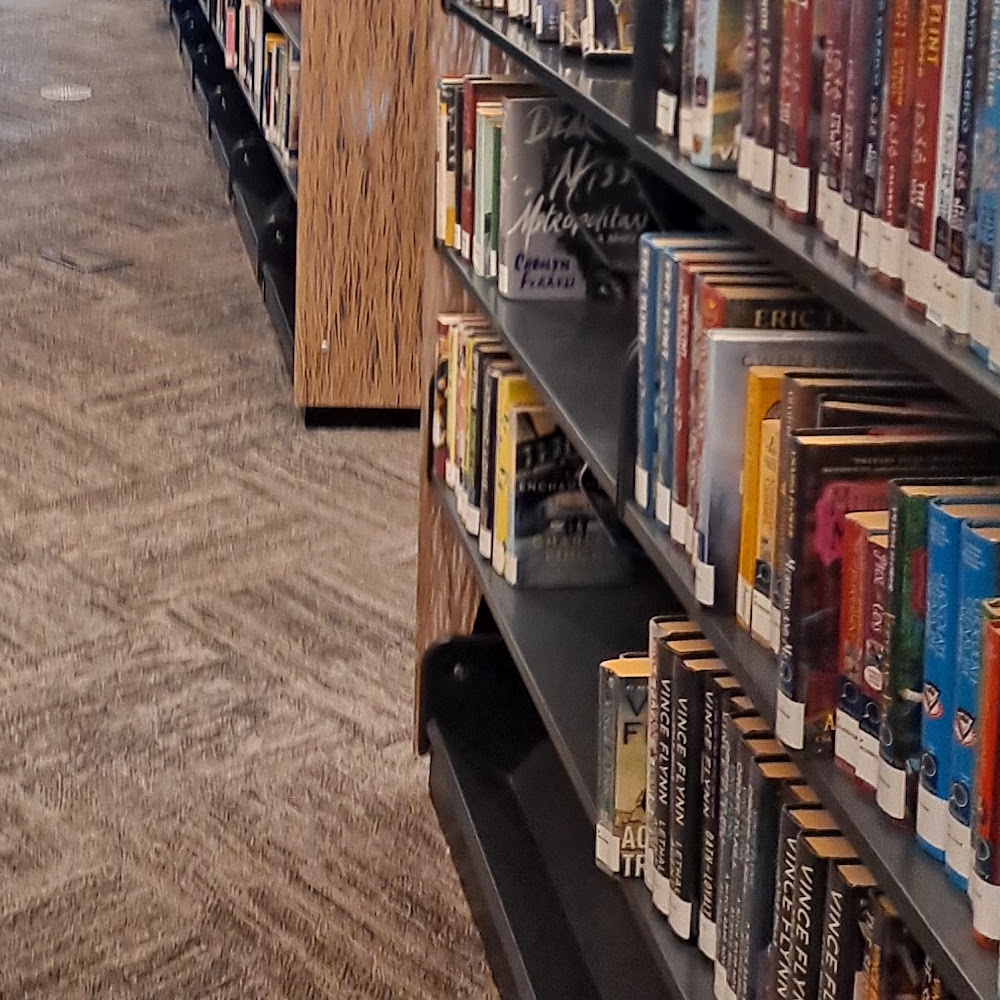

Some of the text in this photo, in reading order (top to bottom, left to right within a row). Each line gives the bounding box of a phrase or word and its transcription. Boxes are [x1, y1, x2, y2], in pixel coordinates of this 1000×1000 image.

[926, 3, 943, 67] FLINT
[754, 309, 810, 329] ERIC
[675, 696, 688, 757] VINCE
[702, 691, 713, 750] VINCE
[656, 678, 671, 872] VINCE FLYNN LETHAL
[674, 761, 686, 826] FLYNN
[701, 754, 711, 818] FLYNN
[777, 837, 798, 998] VINCE FLYNN
[796, 865, 814, 946] VINCE
[825, 890, 844, 973] VINCE
